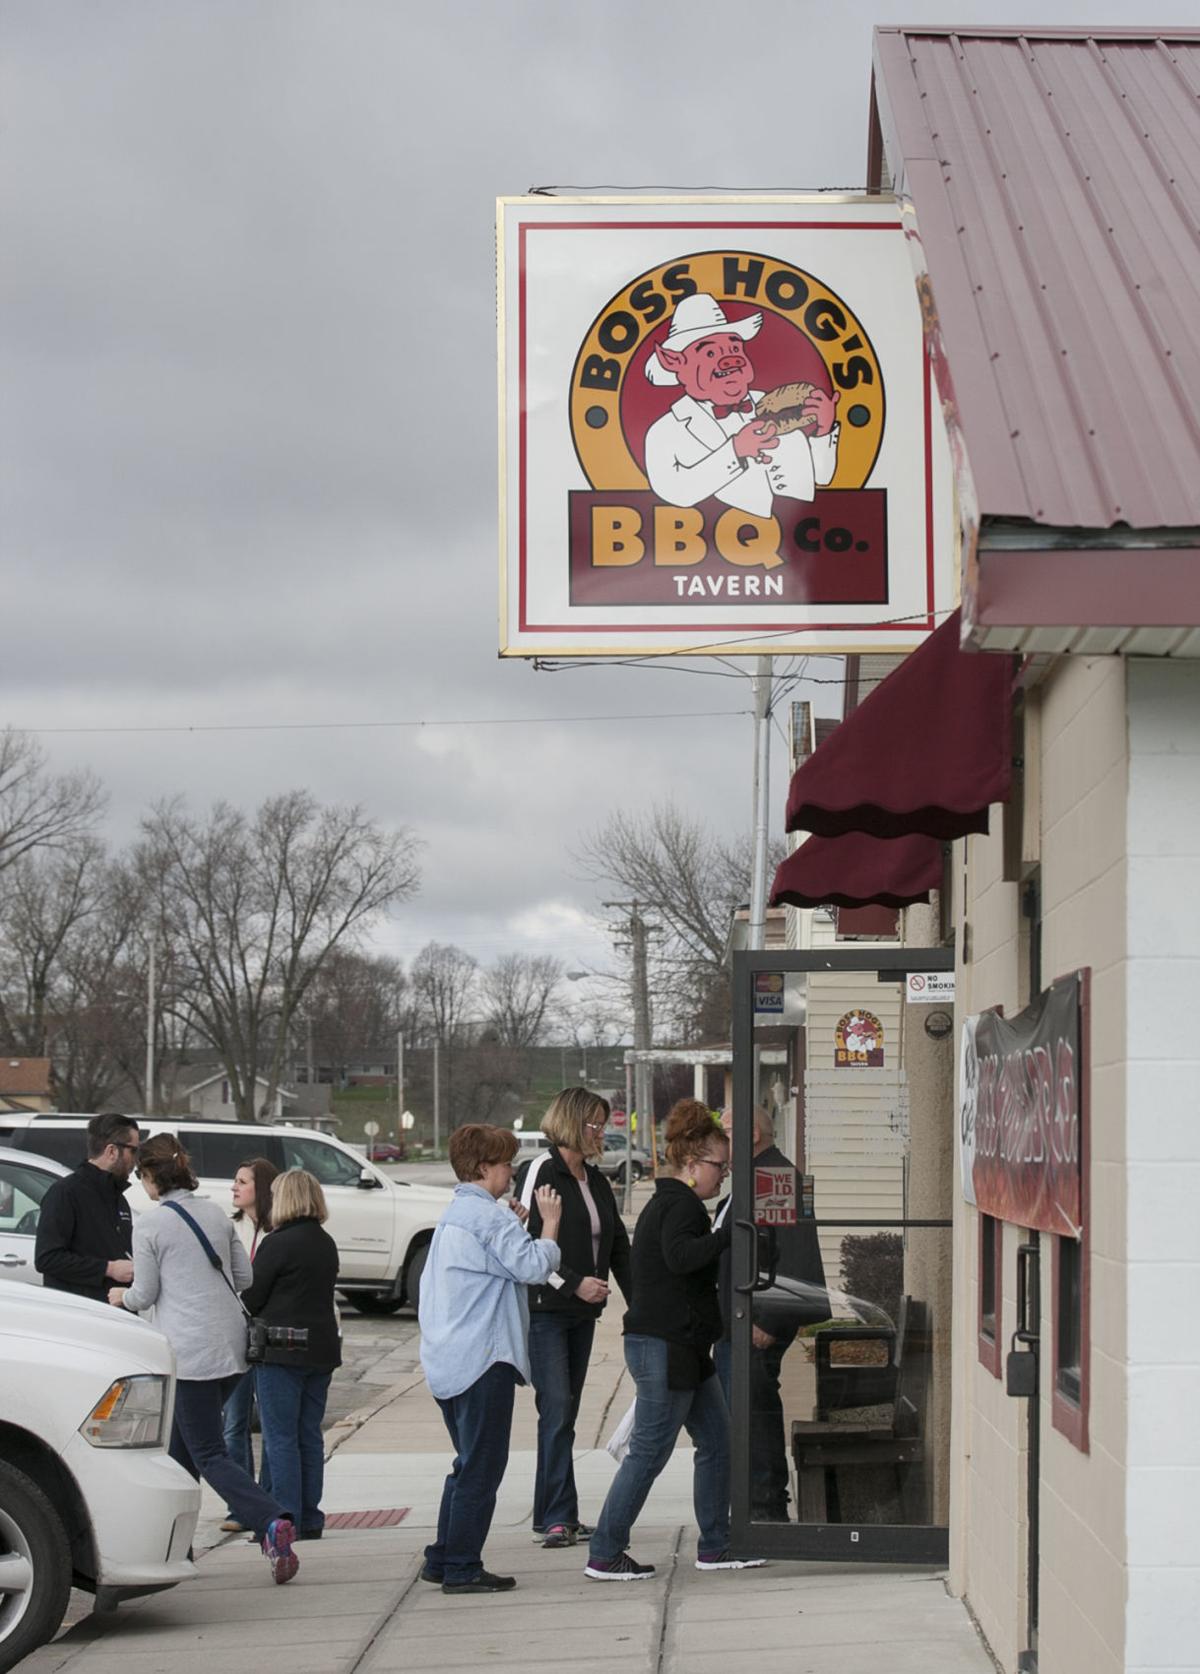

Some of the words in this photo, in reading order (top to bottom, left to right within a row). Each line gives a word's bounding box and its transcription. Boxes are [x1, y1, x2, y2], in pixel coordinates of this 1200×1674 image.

[579, 263, 698, 392] BOSS
[722, 257, 874, 391] HOG'S
[590, 505, 788, 570] BBQ
[793, 517, 869, 552] Co.
[673, 575, 783, 596] TAVERN
[759, 996, 782, 1006] VISA
[837, 1050, 868, 1062] BBQ
[774, 1174, 792, 1183] WE
[754, 1208, 796, 1223] PULL
